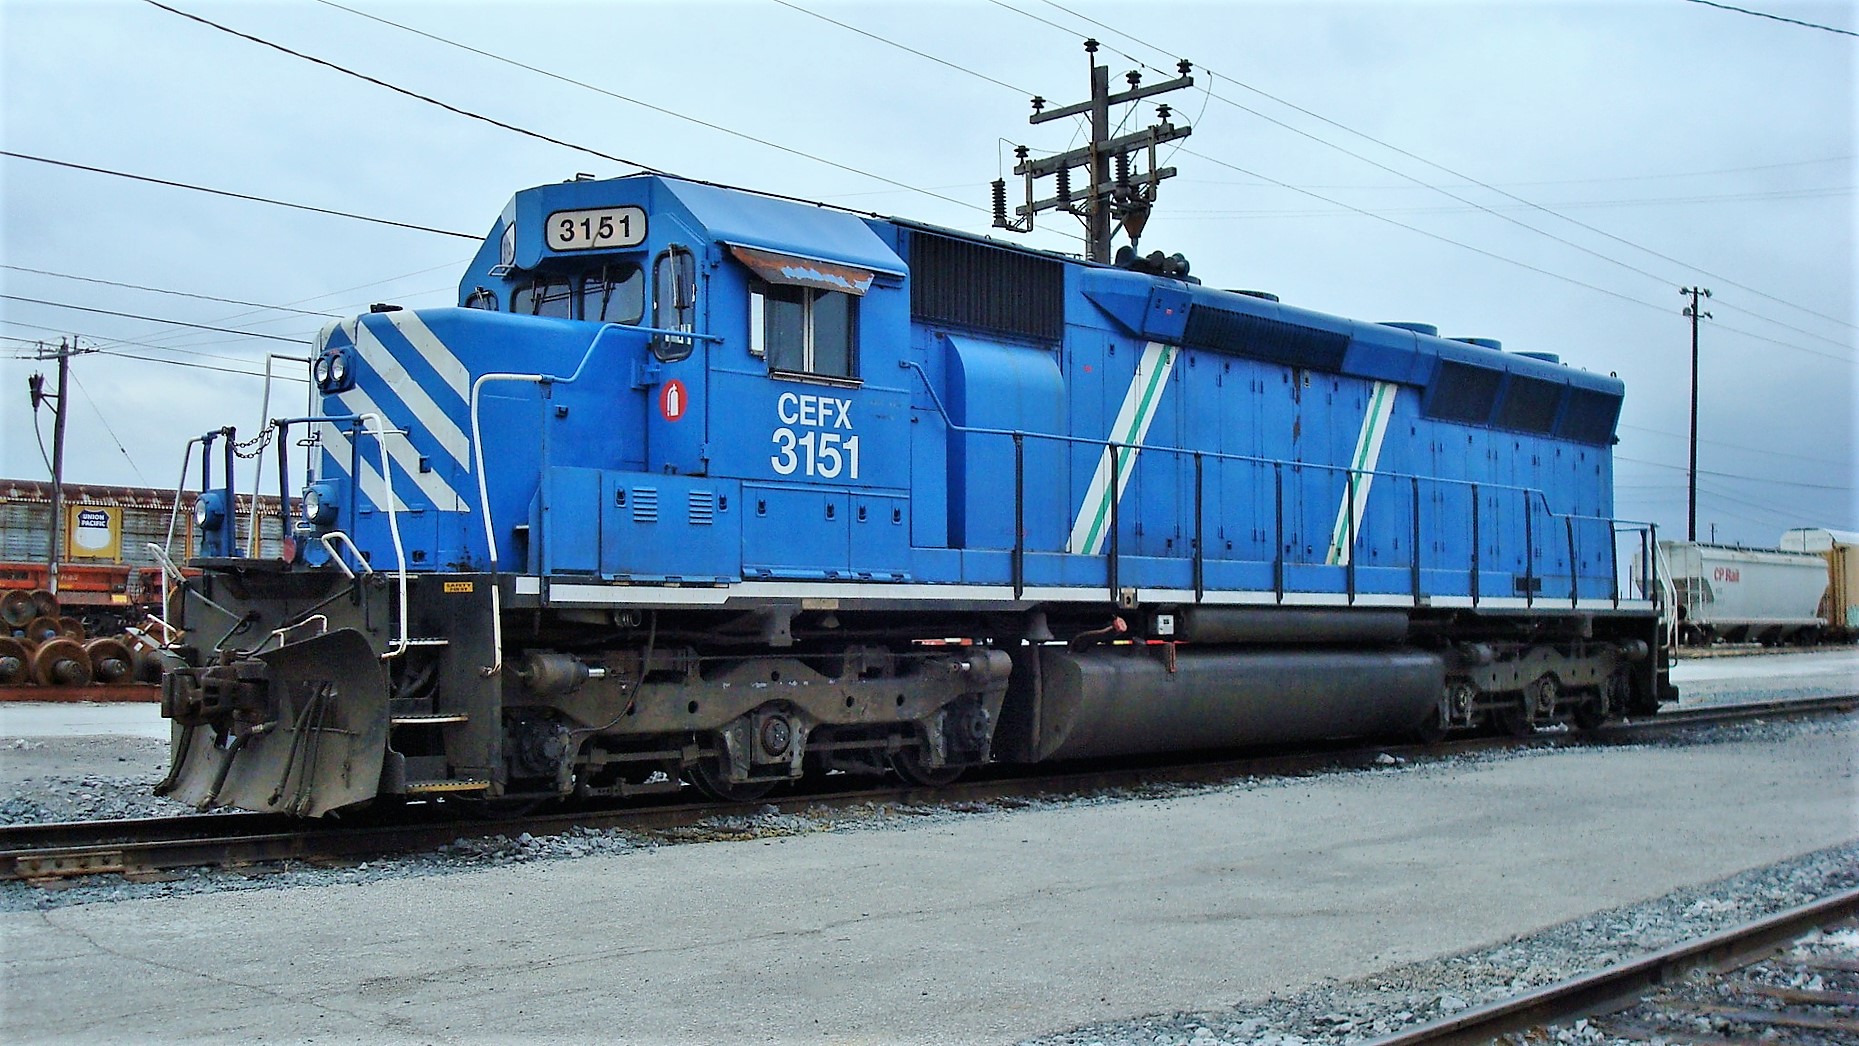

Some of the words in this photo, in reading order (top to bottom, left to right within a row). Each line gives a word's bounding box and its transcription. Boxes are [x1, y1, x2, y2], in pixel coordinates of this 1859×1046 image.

[559, 214, 630, 242] 3151
[777, 392, 853, 430] CEFX
[771, 427, 859, 479] 3151
[1714, 567, 1725, 582] CP
[1725, 567, 1740, 583] Rail
